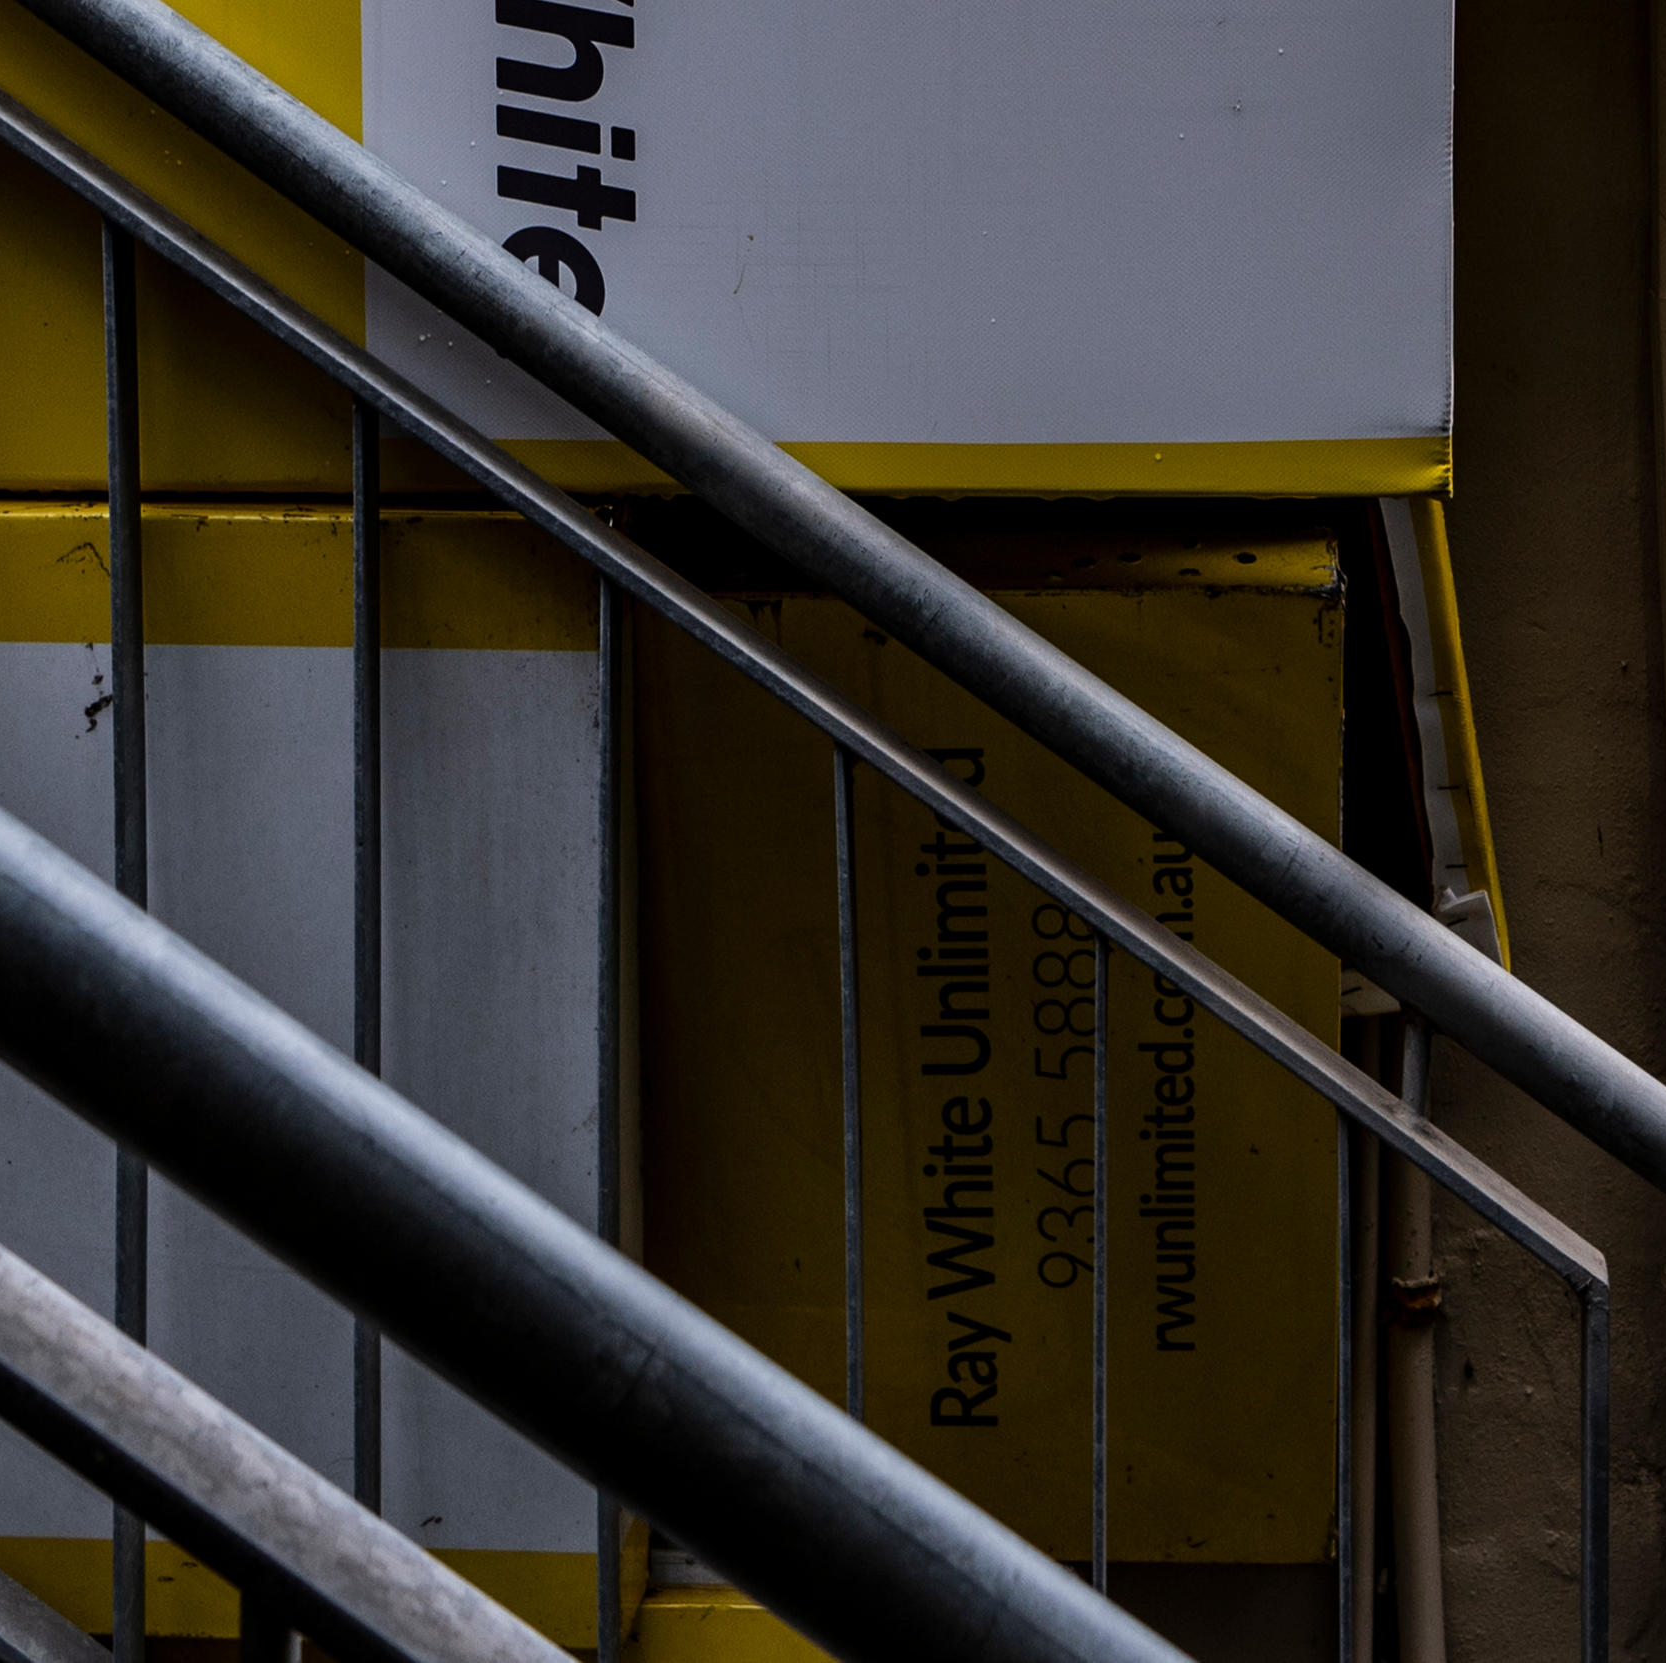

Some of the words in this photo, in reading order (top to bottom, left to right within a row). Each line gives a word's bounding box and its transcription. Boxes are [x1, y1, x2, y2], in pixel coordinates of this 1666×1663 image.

[915, 746, 991, 1077] Unlimitd
[1033, 901, 1097, 1080] 5888
[923, 1095, 995, 1300] White
[1036, 1112, 1097, 1289] 9365
[930, 1312, 1013, 1428] Ray
